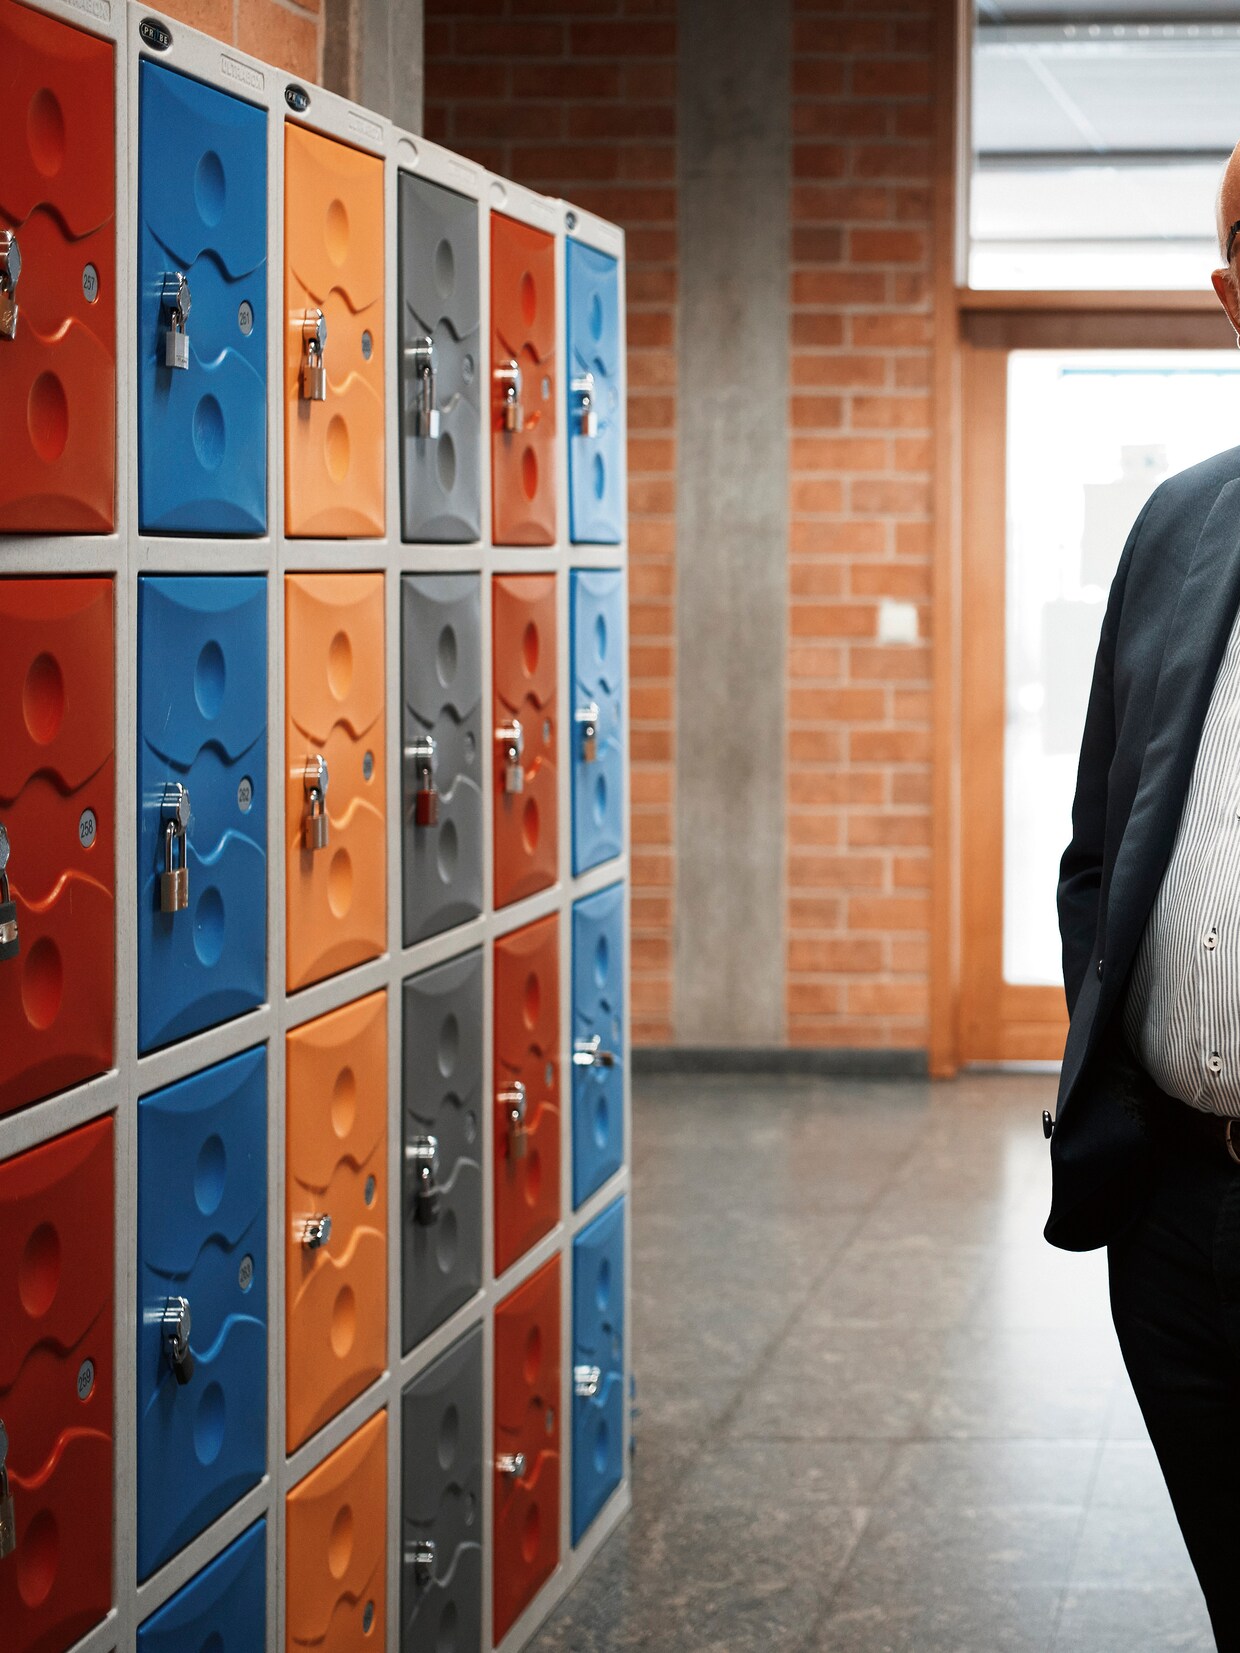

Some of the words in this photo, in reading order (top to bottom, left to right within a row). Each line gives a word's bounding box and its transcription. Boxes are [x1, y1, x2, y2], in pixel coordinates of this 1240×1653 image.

[83, 274, 95, 291] 257
[239, 311, 250, 326] 261
[239, 788, 250, 802] 262
[80, 819, 94, 839] 258
[78, 1367, 91, 1393] 259
